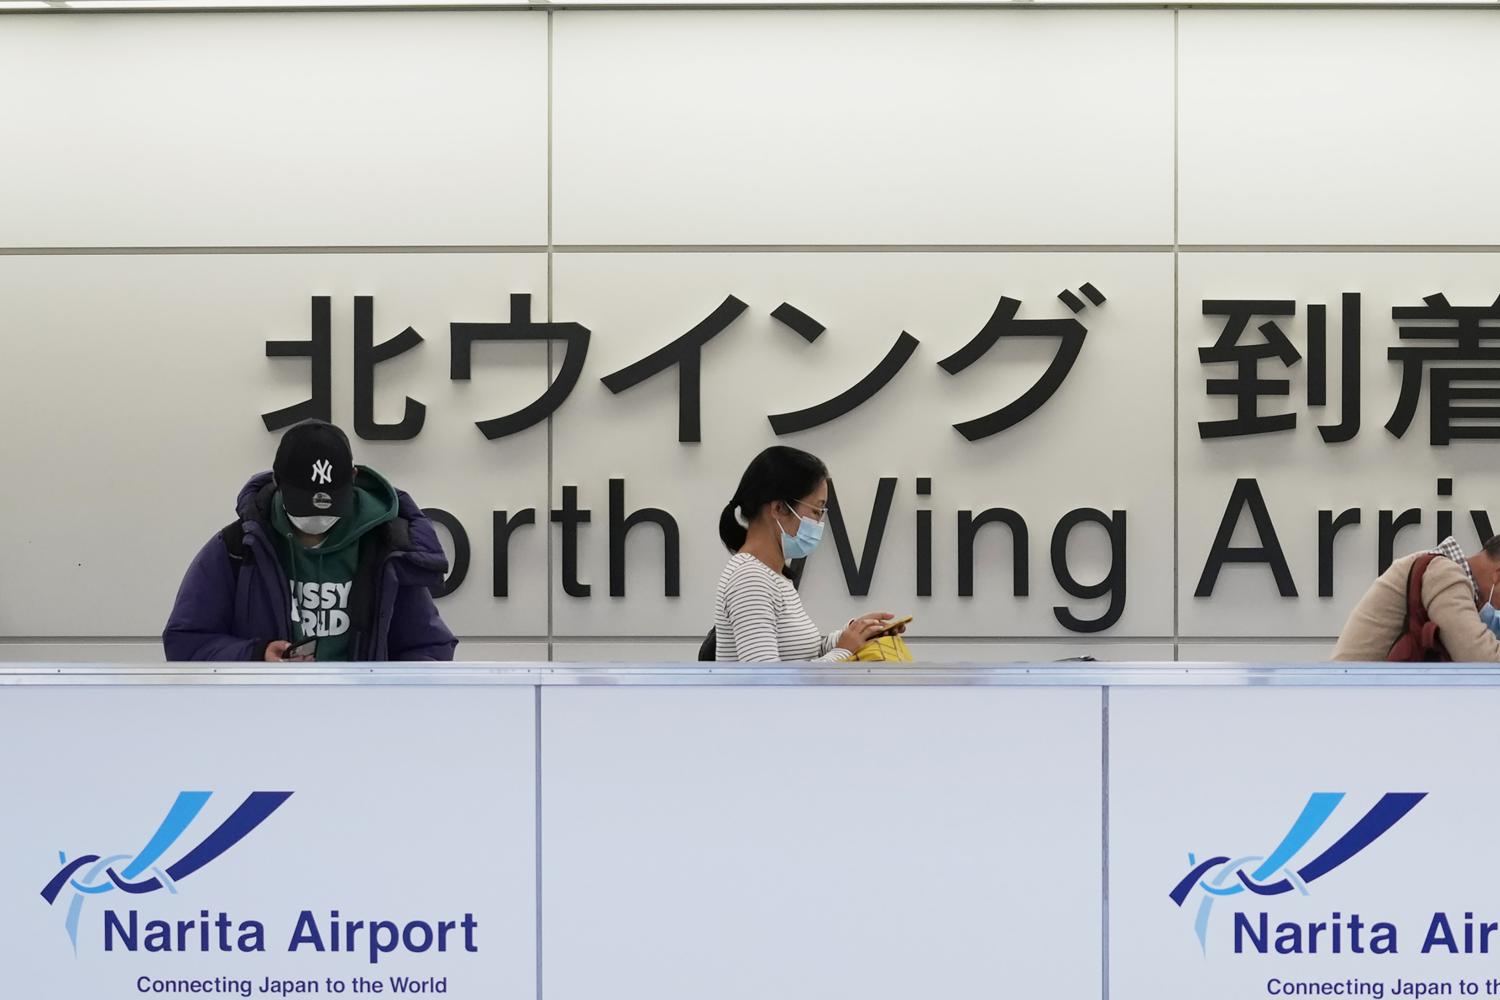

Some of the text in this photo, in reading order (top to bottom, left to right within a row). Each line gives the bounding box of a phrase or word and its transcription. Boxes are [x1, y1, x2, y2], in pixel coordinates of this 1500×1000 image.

[262, 281, 1107, 442] 北ウイング
[311, 459, 333, 484] NY
[420, 477, 681, 598] orth
[103, 909, 479, 964] Narita Airport
[1233, 911, 1399, 955] Narita
[136, 975, 447, 998] Connecting Japan to the World
[1266, 978, 1384, 1000] Connecting
[1390, 978, 1452, 1000] Japan
[1458, 979, 1479, 996] to
